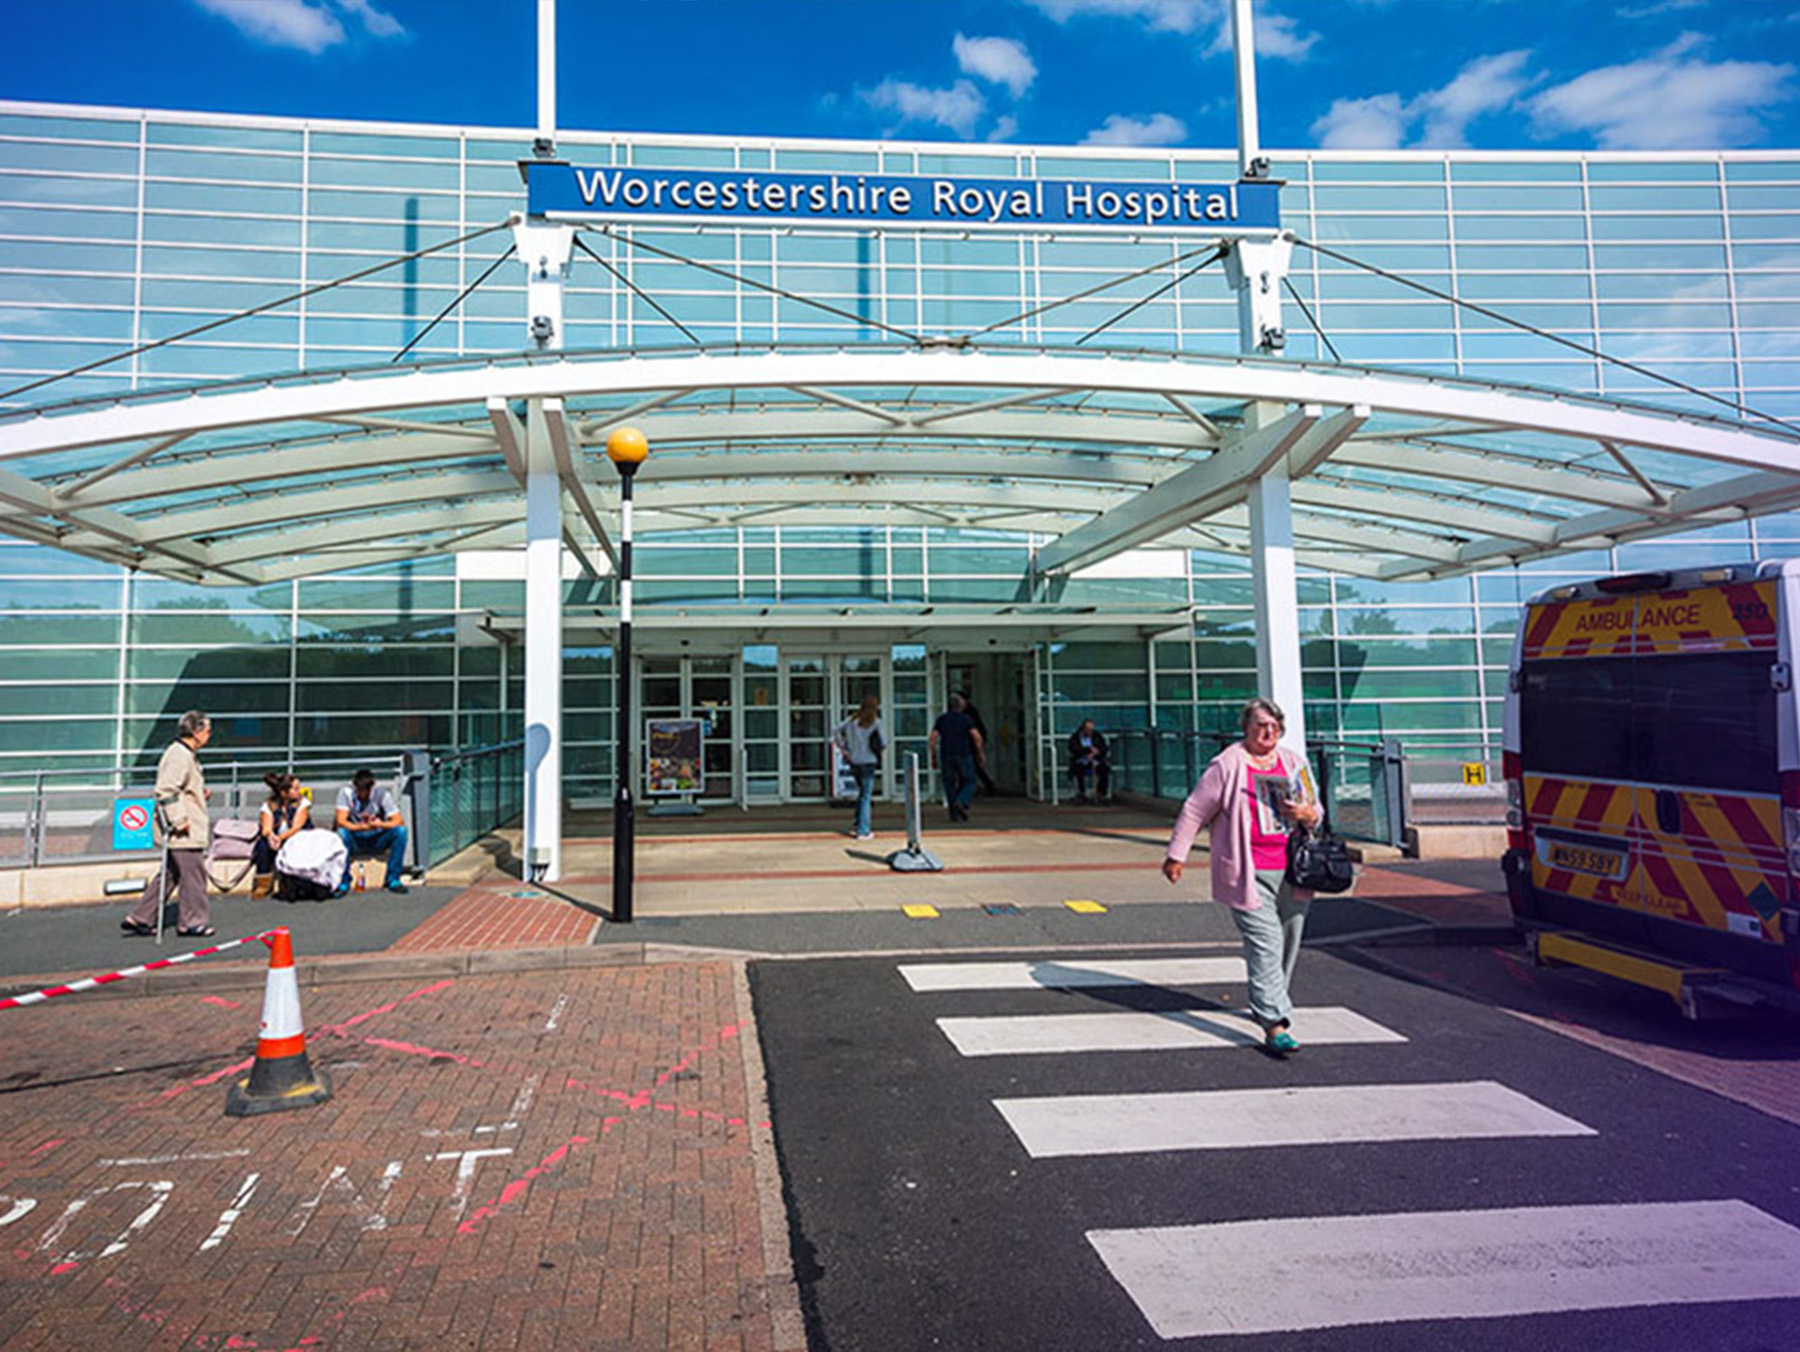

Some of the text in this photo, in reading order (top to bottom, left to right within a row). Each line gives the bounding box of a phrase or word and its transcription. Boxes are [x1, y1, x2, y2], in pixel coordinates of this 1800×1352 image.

[575, 169, 1240, 225] Worcestershire Royal Hospital
[1466, 767, 1482, 784] H
